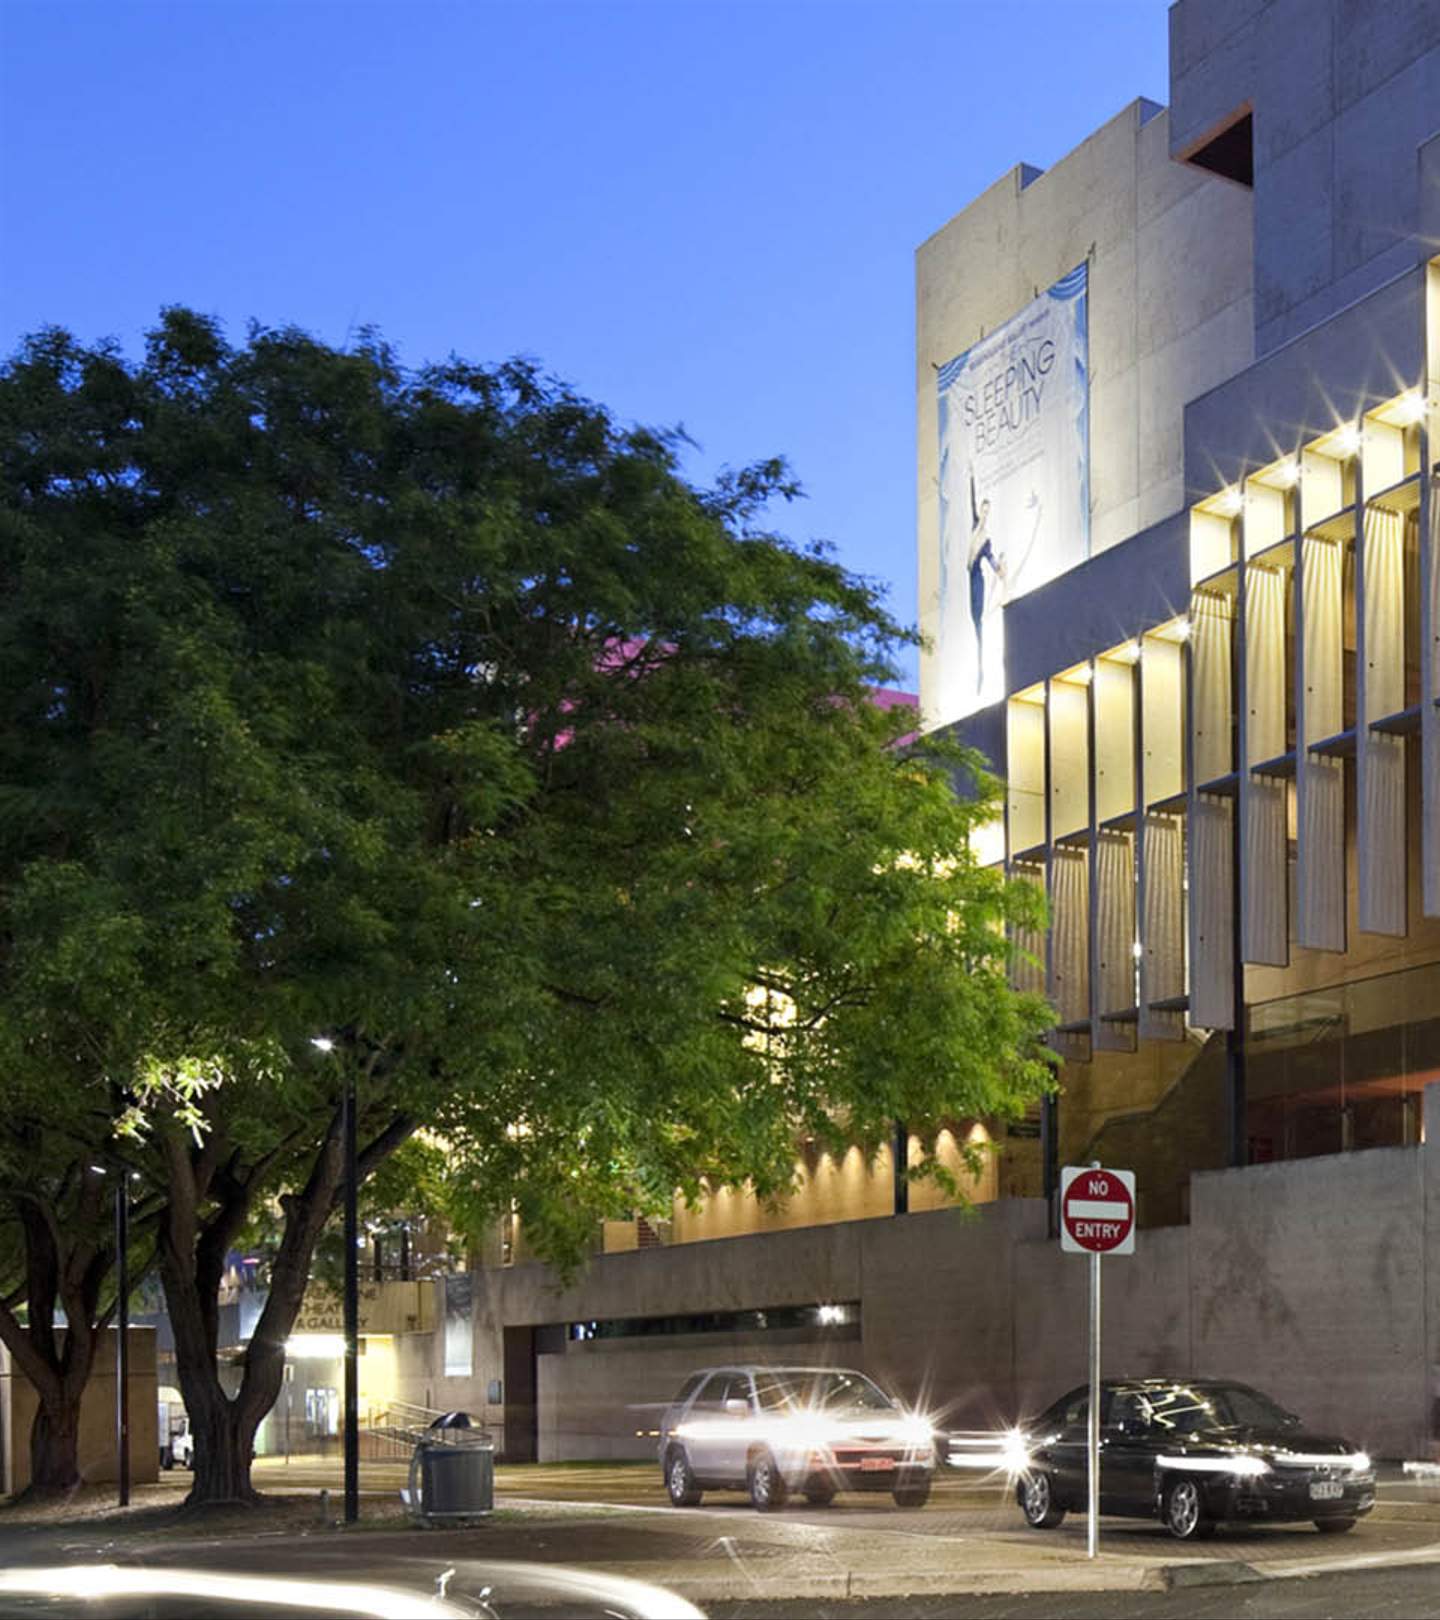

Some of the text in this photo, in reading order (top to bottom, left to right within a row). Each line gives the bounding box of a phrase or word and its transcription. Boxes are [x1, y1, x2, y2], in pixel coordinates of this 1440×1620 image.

[964, 339, 1056, 427] SLEEPING
[975, 380, 1044, 453] BEAUTY
[1088, 1180, 1109, 1196] NO
[1075, 1222, 1121, 1239] ENTRY
